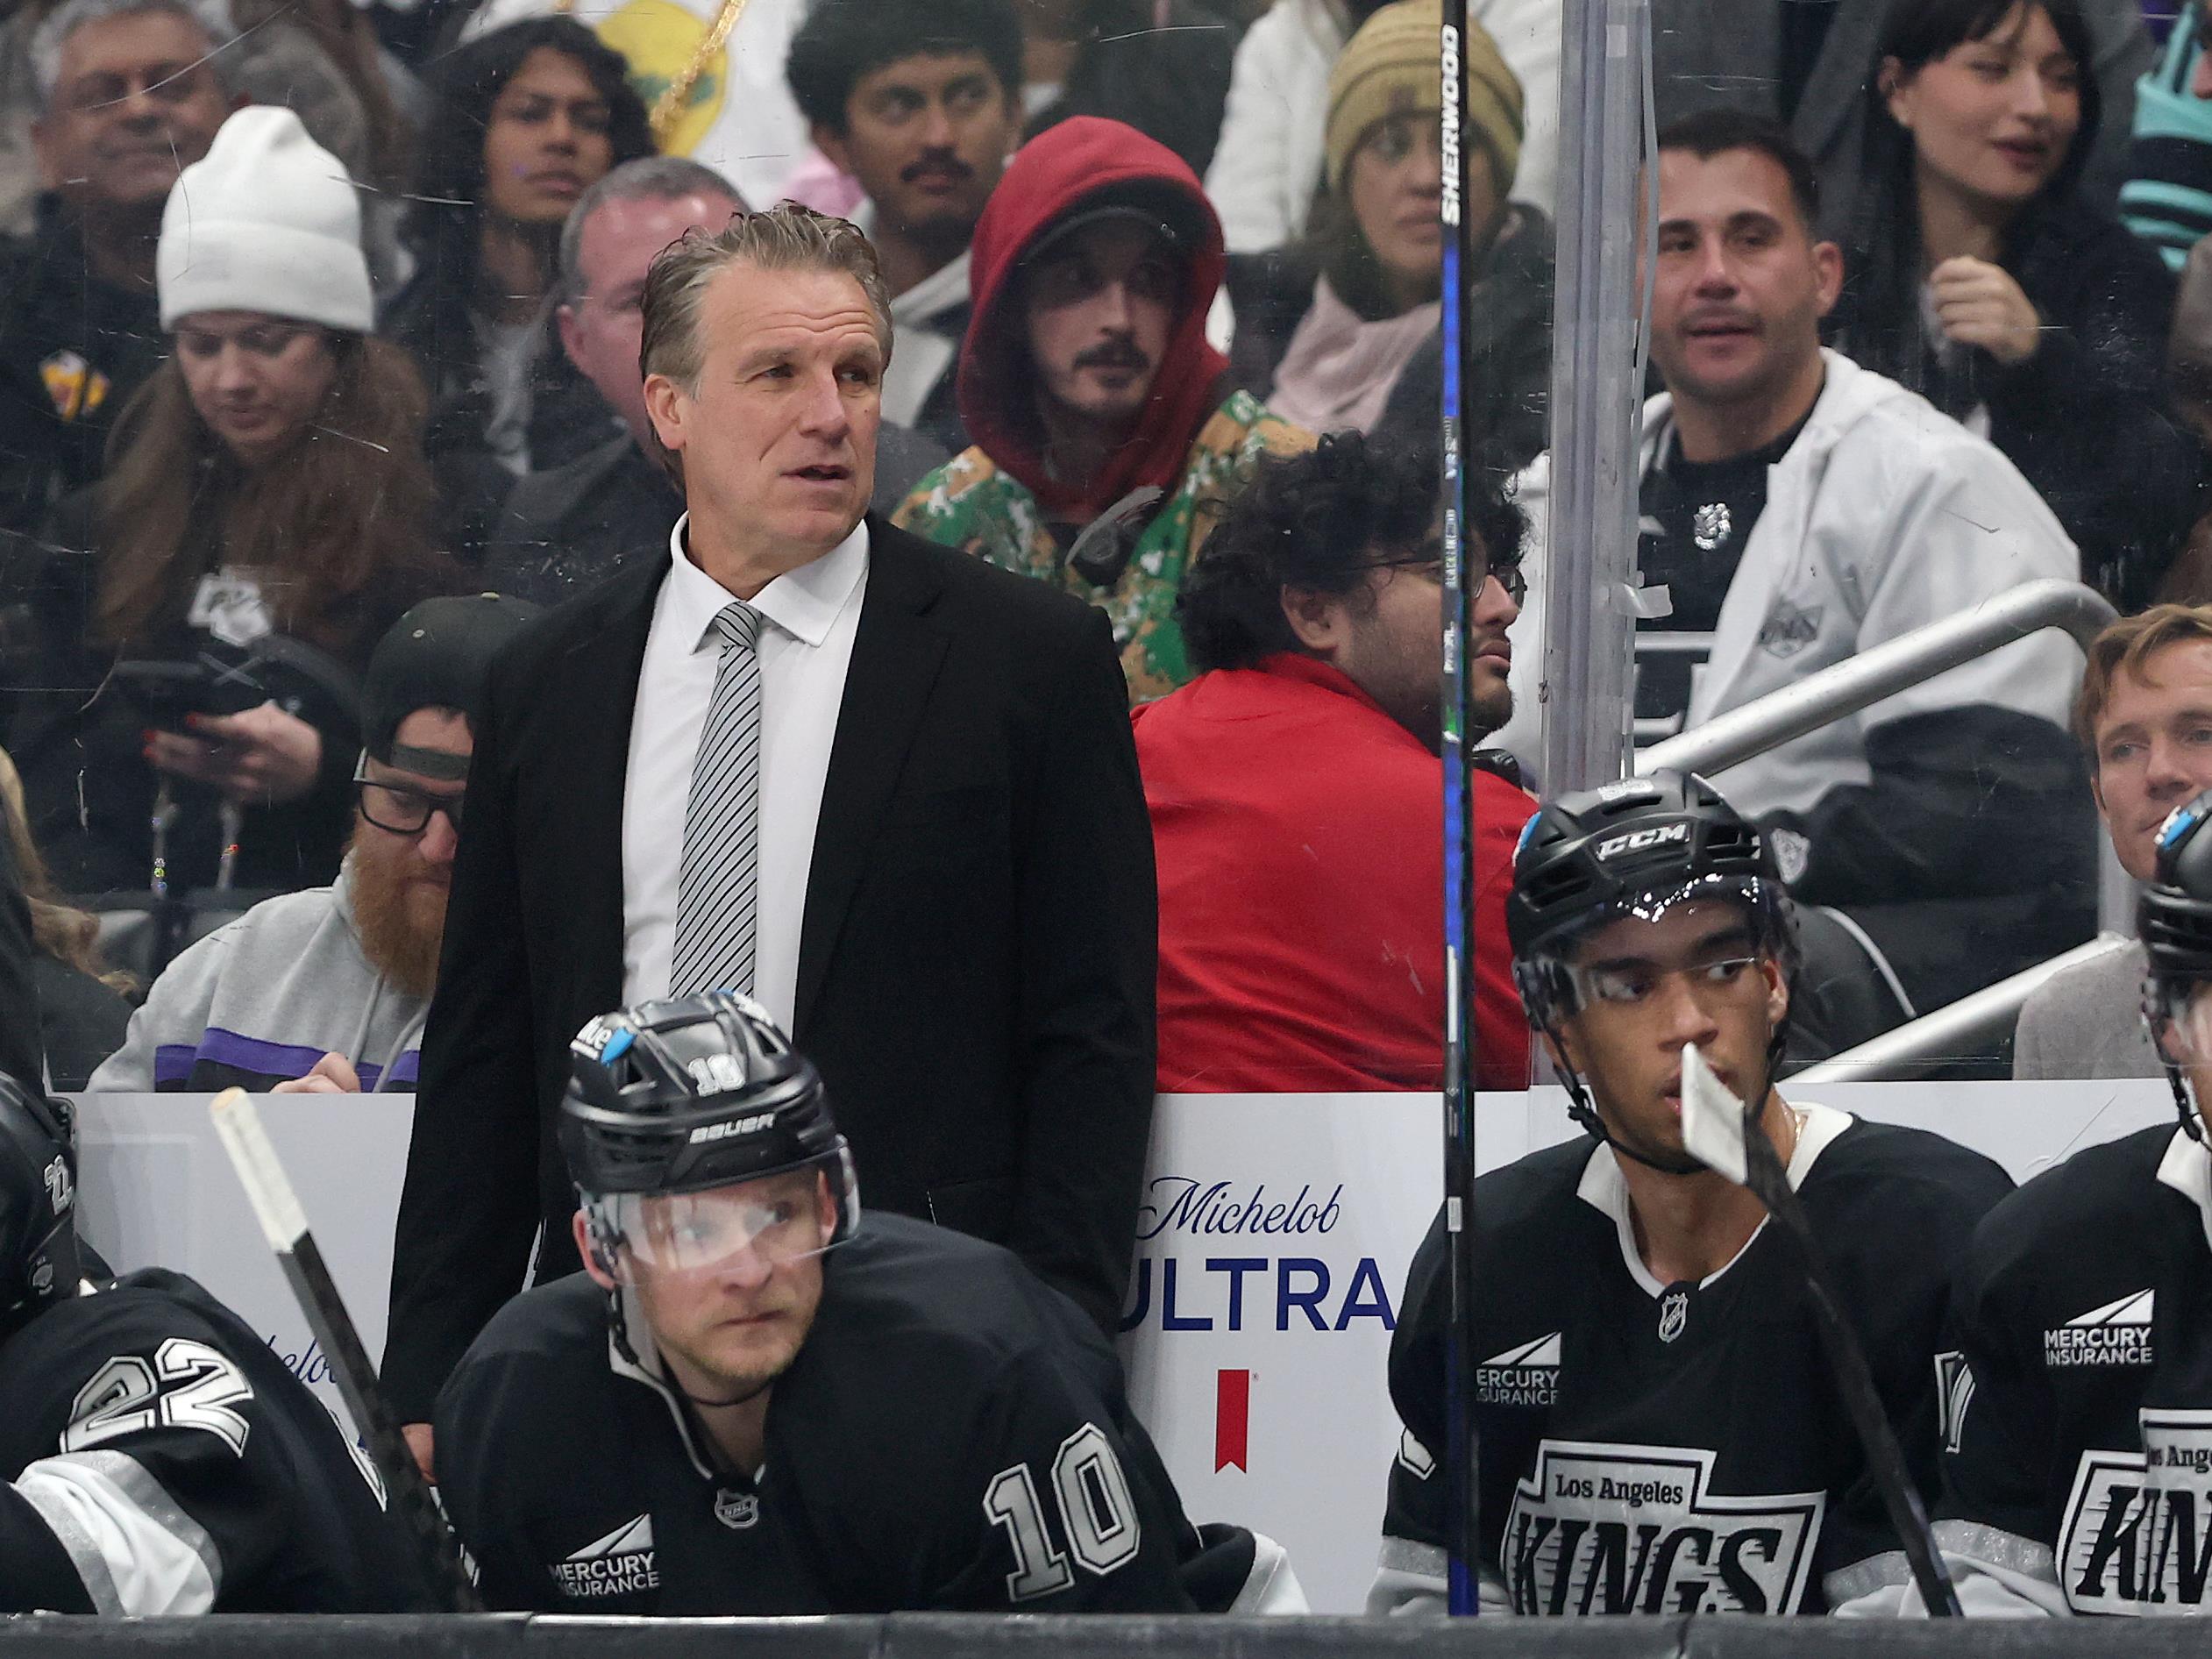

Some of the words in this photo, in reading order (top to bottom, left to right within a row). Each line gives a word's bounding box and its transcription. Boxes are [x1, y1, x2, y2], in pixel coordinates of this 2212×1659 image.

[1441, 24, 1461, 226] SHERWOOD
[1596, 823, 1690, 862] CCM
[687, 1053, 745, 1097] 10
[689, 1112, 776, 1144] BAUER
[1136, 1177, 1345, 1241] Michelob
[2045, 1327, 2152, 1349] MERCURY
[2045, 1346, 2153, 1366] INSURANCE
[59, 1337, 255, 1459] 22
[1475, 1368, 1560, 1388] ERCURY
[983, 1421, 1140, 1603] 10
[1555, 1474, 1593, 1497] Los
[1599, 1477, 1683, 1507] Angeles
[1514, 1513, 1782, 1615] KINGS
[2075, 1485, 2212, 1605] KIN
